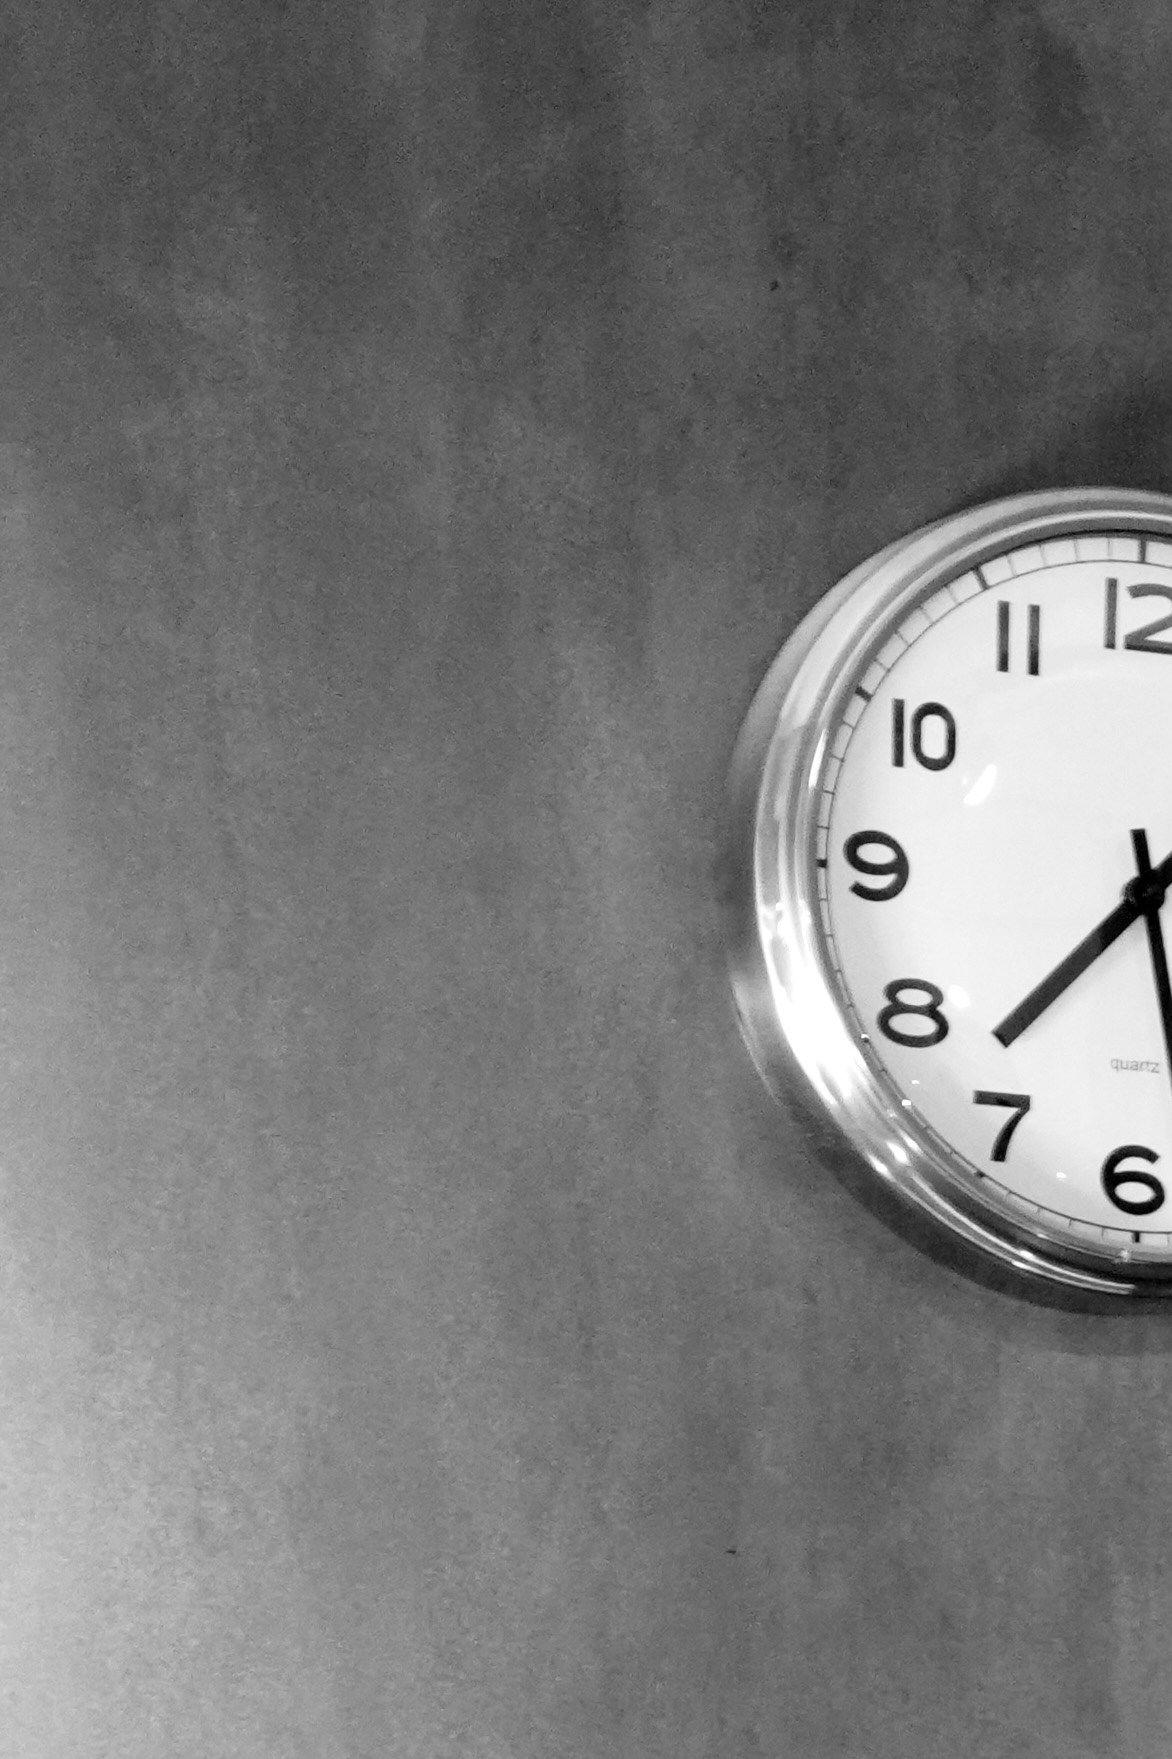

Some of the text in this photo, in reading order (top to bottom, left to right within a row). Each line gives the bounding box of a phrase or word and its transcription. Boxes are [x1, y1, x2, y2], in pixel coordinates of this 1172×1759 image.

[997, 600, 1041, 676] 11
[892, 698, 957, 772] 10
[842, 829, 910, 903] 9
[876, 978, 950, 1049] 8
[1110, 1058, 1160, 1074] quartz
[972, 1090, 1031, 1162] 7
[1100, 1144, 1166, 1217] 6
